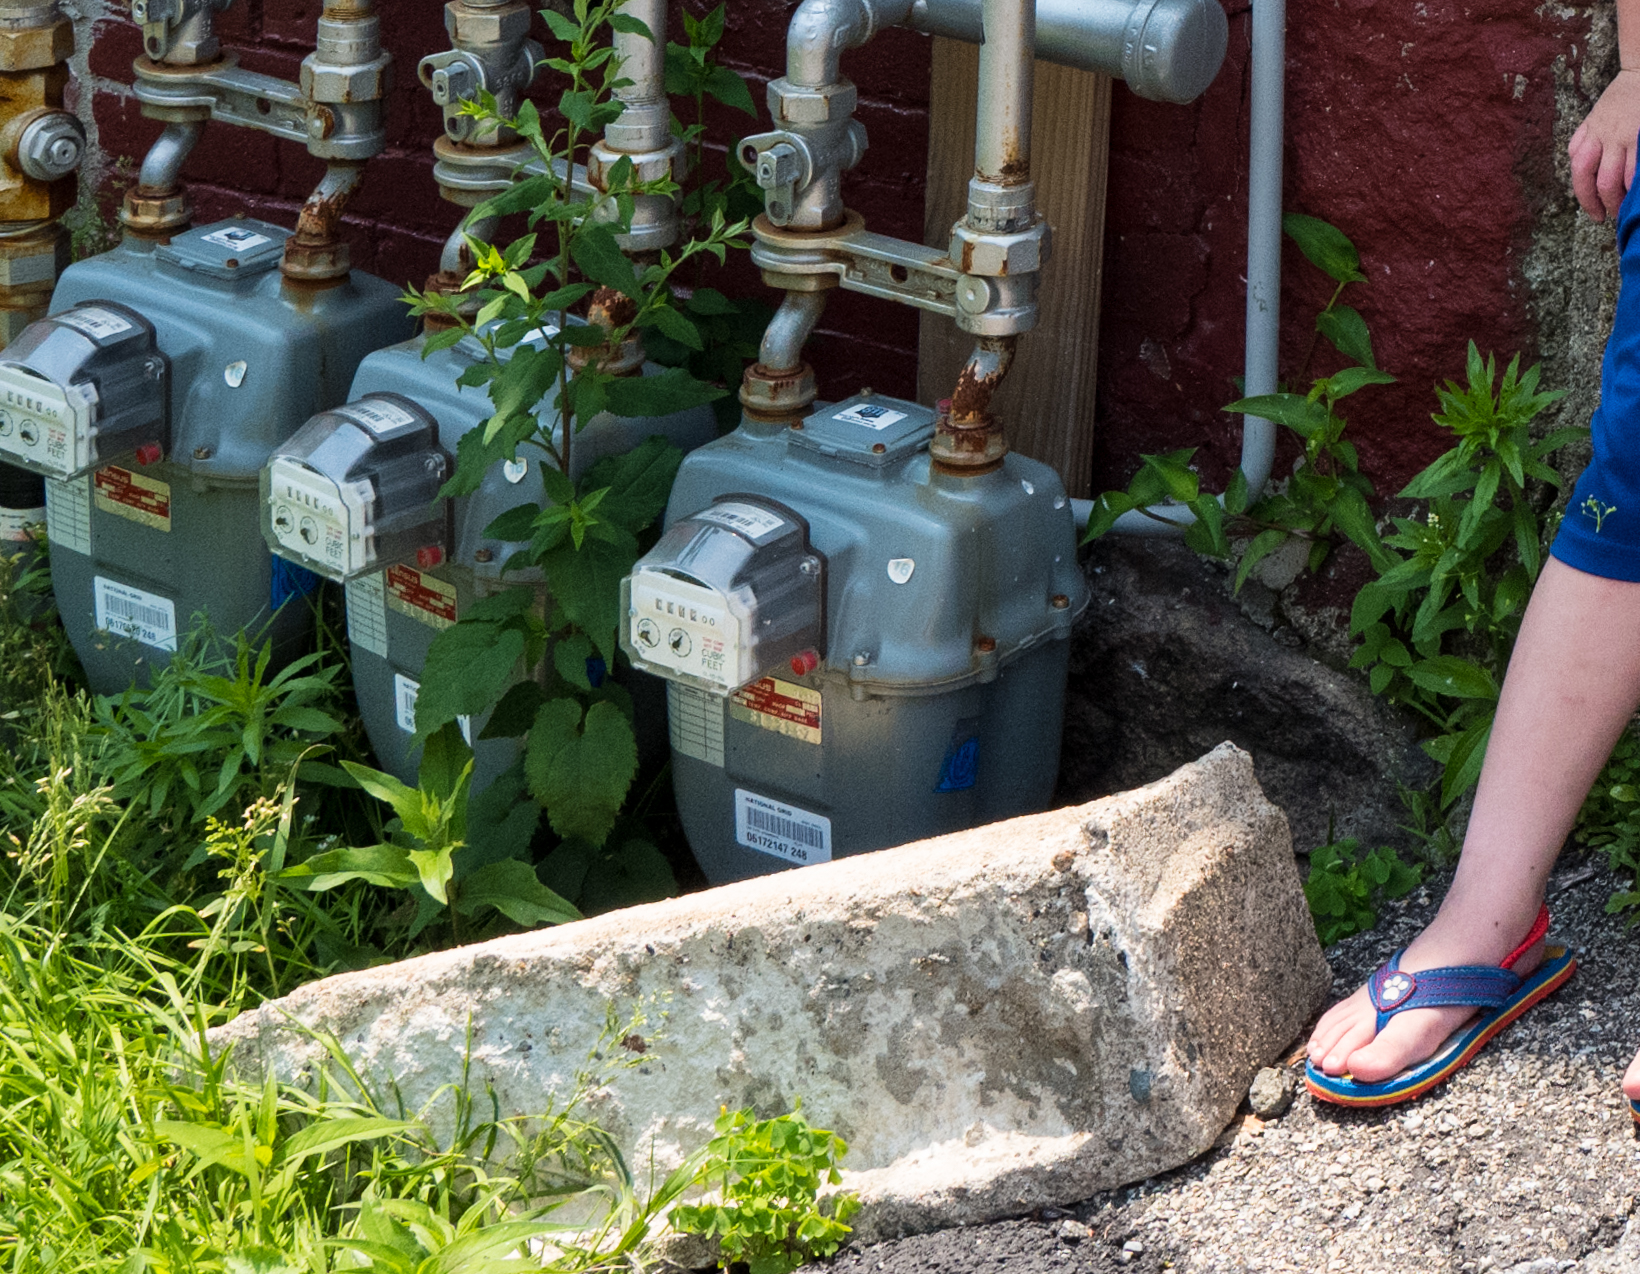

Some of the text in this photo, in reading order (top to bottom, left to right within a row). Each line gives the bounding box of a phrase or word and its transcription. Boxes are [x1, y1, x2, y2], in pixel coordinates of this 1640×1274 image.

[142, 627, 157, 642] 248
[702, 648, 726, 664] CUBIC
[702, 658, 724, 672] FEET
[745, 797, 792, 817] NATIONAL GRID
[791, 847, 808, 861] 248
